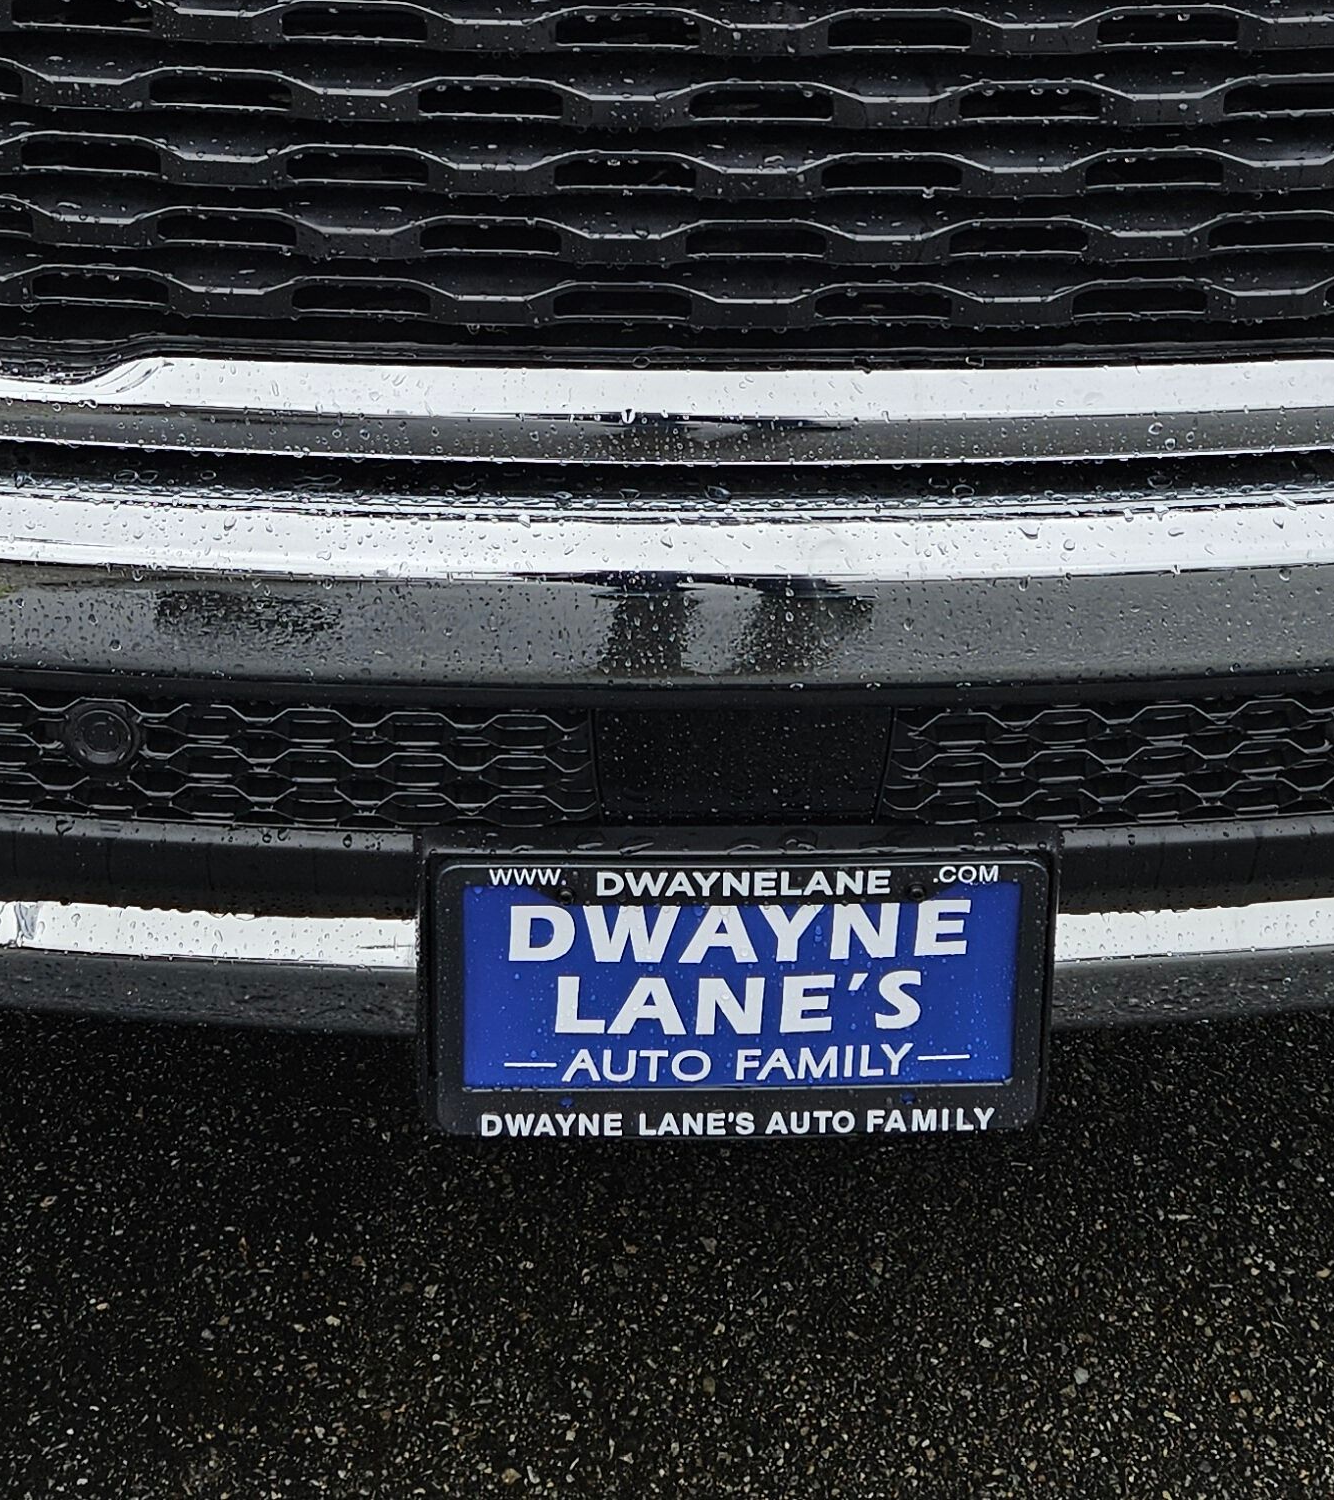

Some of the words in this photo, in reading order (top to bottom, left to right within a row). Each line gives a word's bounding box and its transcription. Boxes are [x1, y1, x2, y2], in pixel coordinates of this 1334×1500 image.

[489, 867, 566, 886] WWW.
[595, 870, 892, 897] DWAYNELANE
[933, 865, 1000, 884] .COM
[508, 899, 973, 964] DWAYNE
[554, 970, 923, 1035] LANE'S
[562, 1048, 711, 1083] AUTO
[735, 1043, 915, 1082] FAMILY
[480, 1113, 623, 1137] DWAYNE
[639, 1111, 756, 1136] LANE'S
[766, 1109, 856, 1135] AUTO
[866, 1107, 996, 1134] FAMILY
